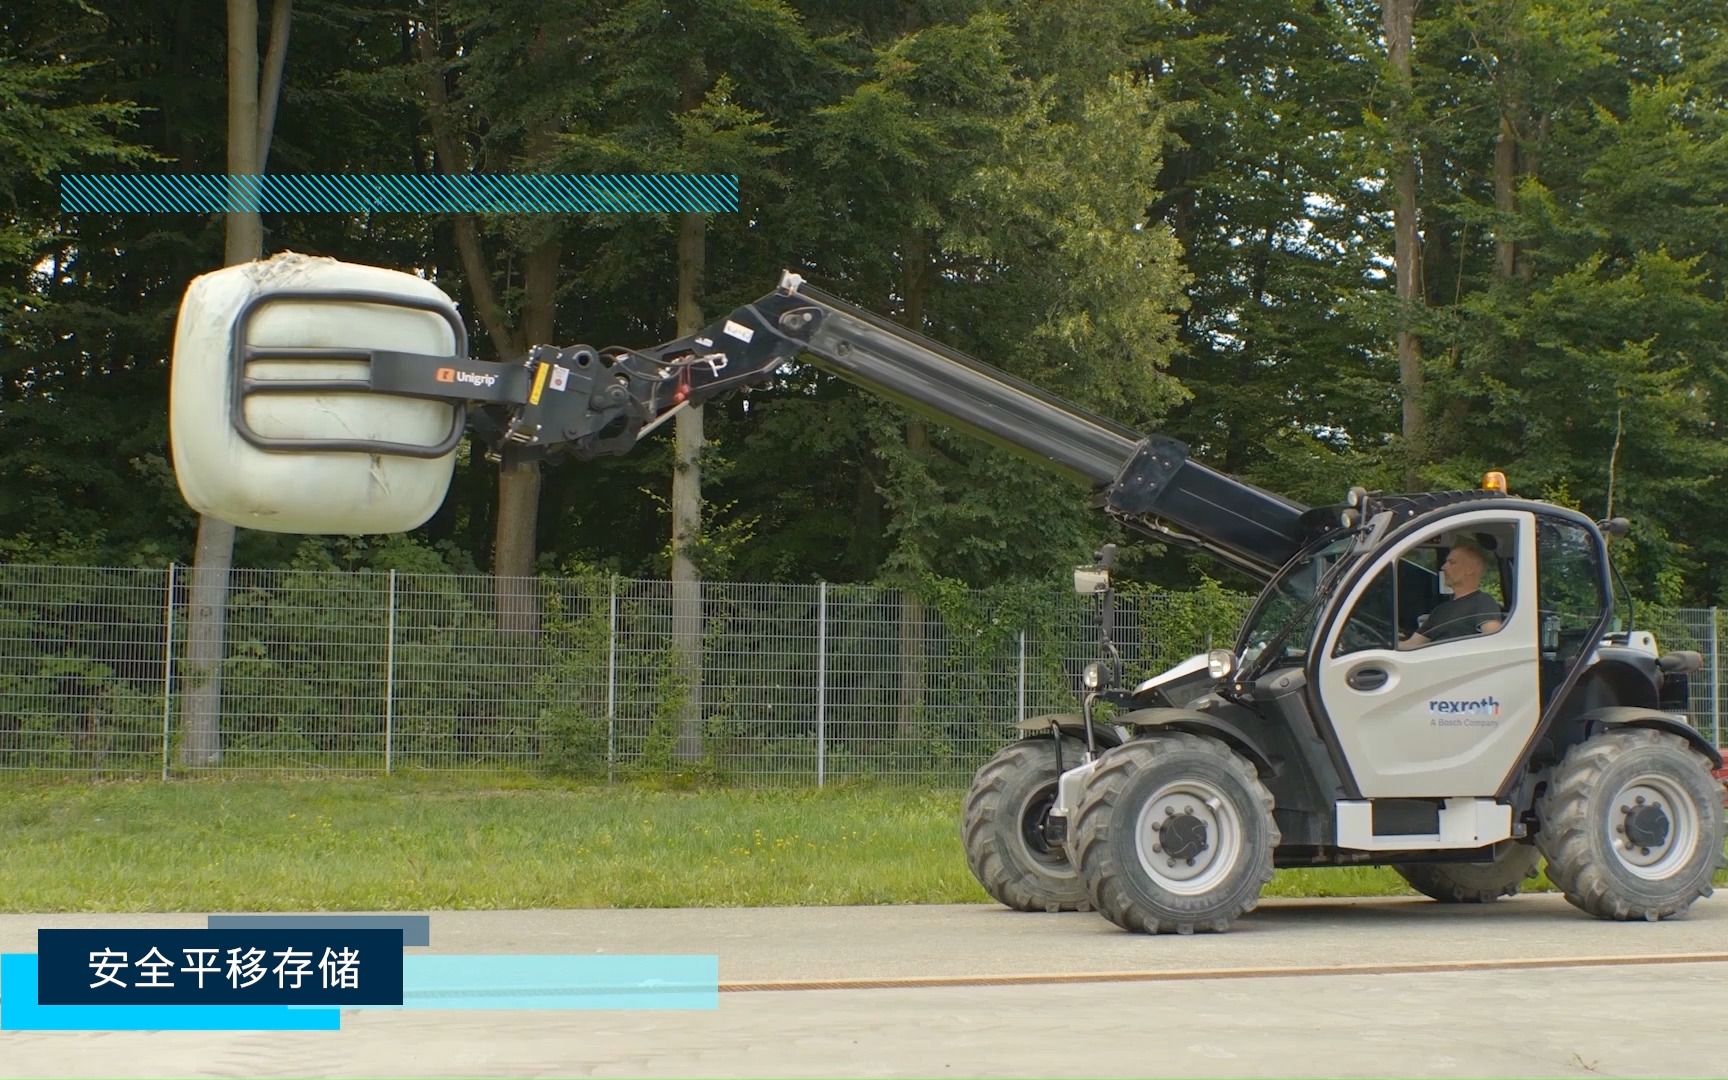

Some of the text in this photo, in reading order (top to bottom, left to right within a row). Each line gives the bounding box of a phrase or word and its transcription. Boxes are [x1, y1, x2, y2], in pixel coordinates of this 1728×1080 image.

[456, 371, 496, 387] Unigrip
[1429, 696, 1499, 714] rexroth
[1430, 718, 1499, 728] A Bosch Company
